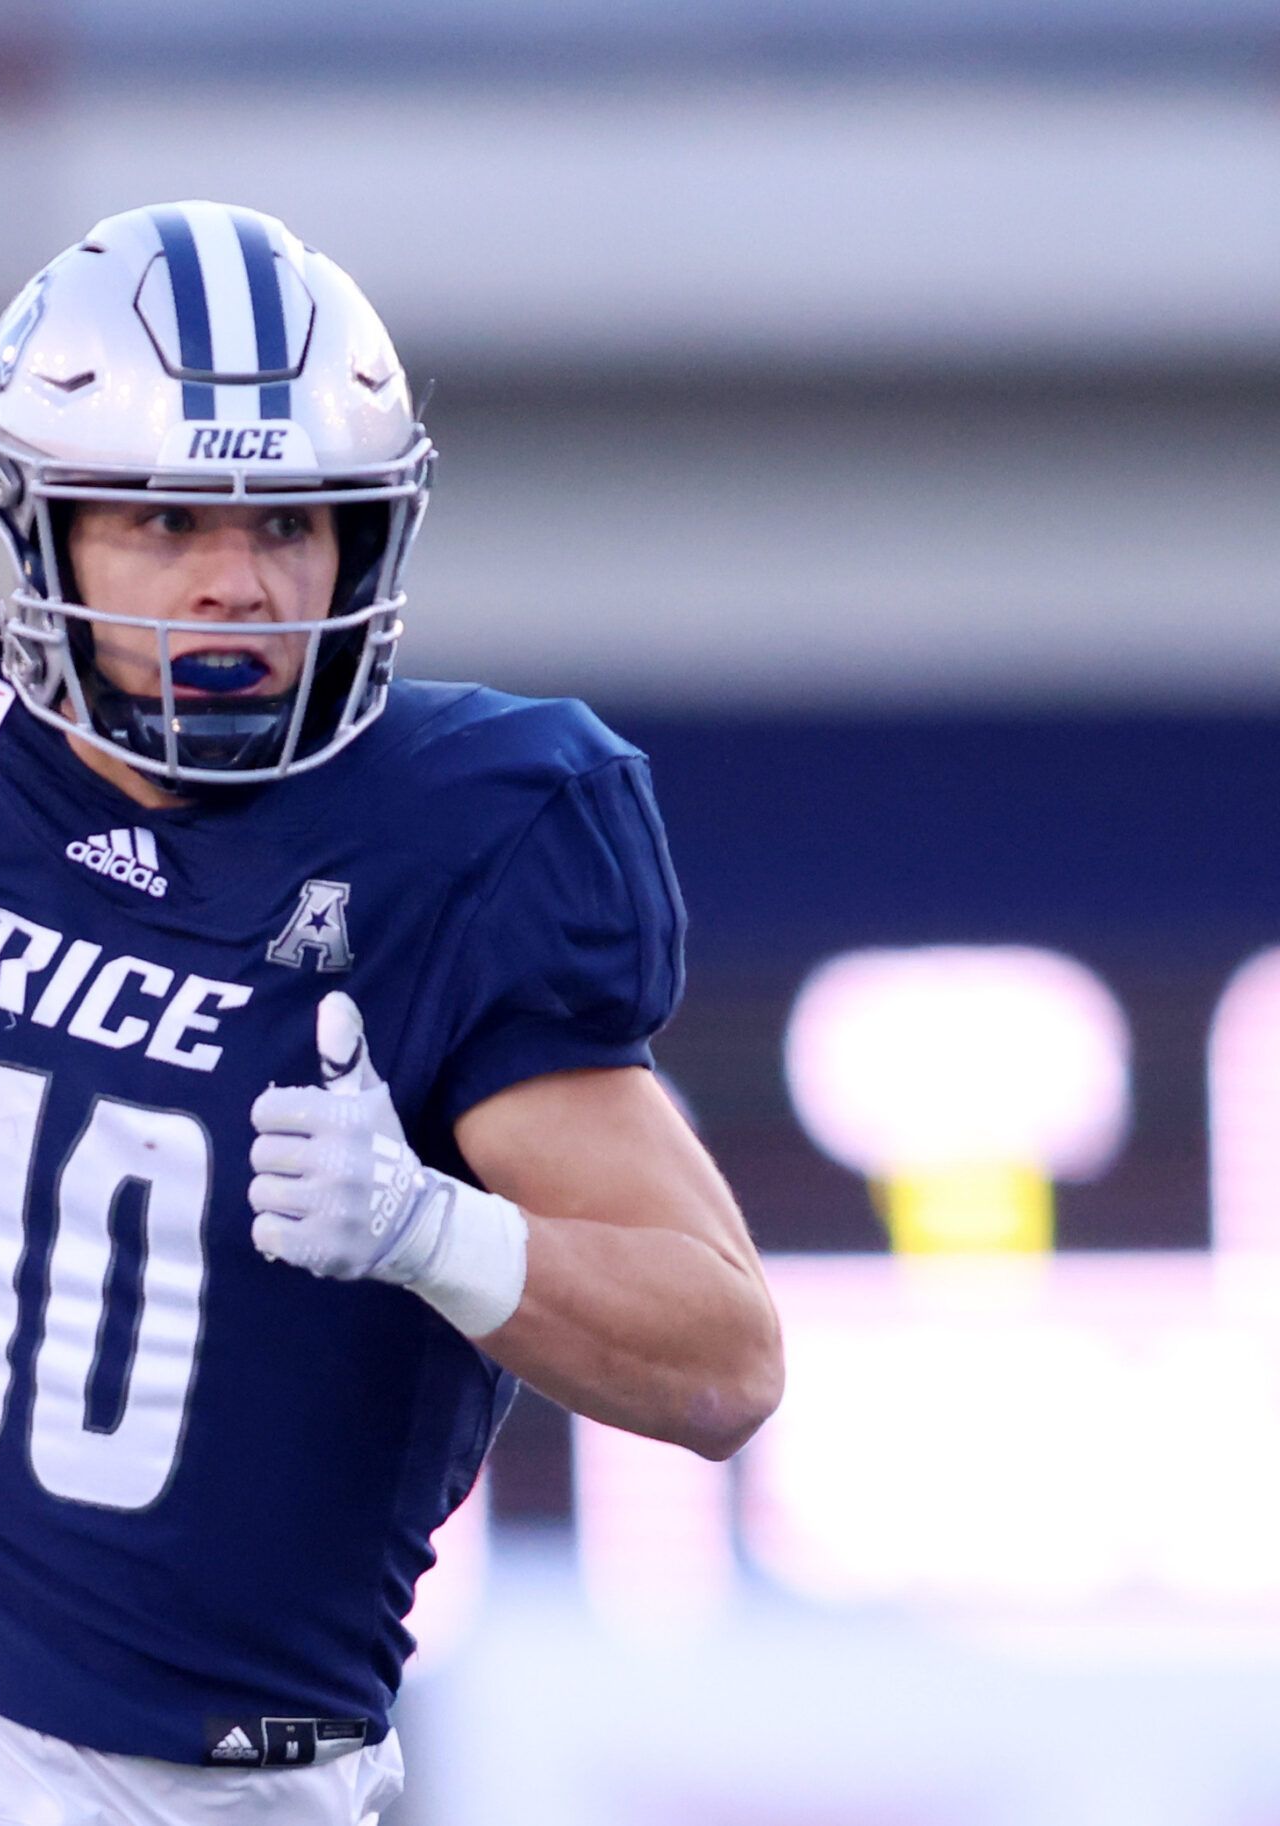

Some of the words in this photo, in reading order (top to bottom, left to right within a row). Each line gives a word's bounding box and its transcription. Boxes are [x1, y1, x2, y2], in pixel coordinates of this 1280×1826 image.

[188, 428, 288, 460] RICE
[65, 841, 168, 898] adidas
[265, 879, 355, 972] A
